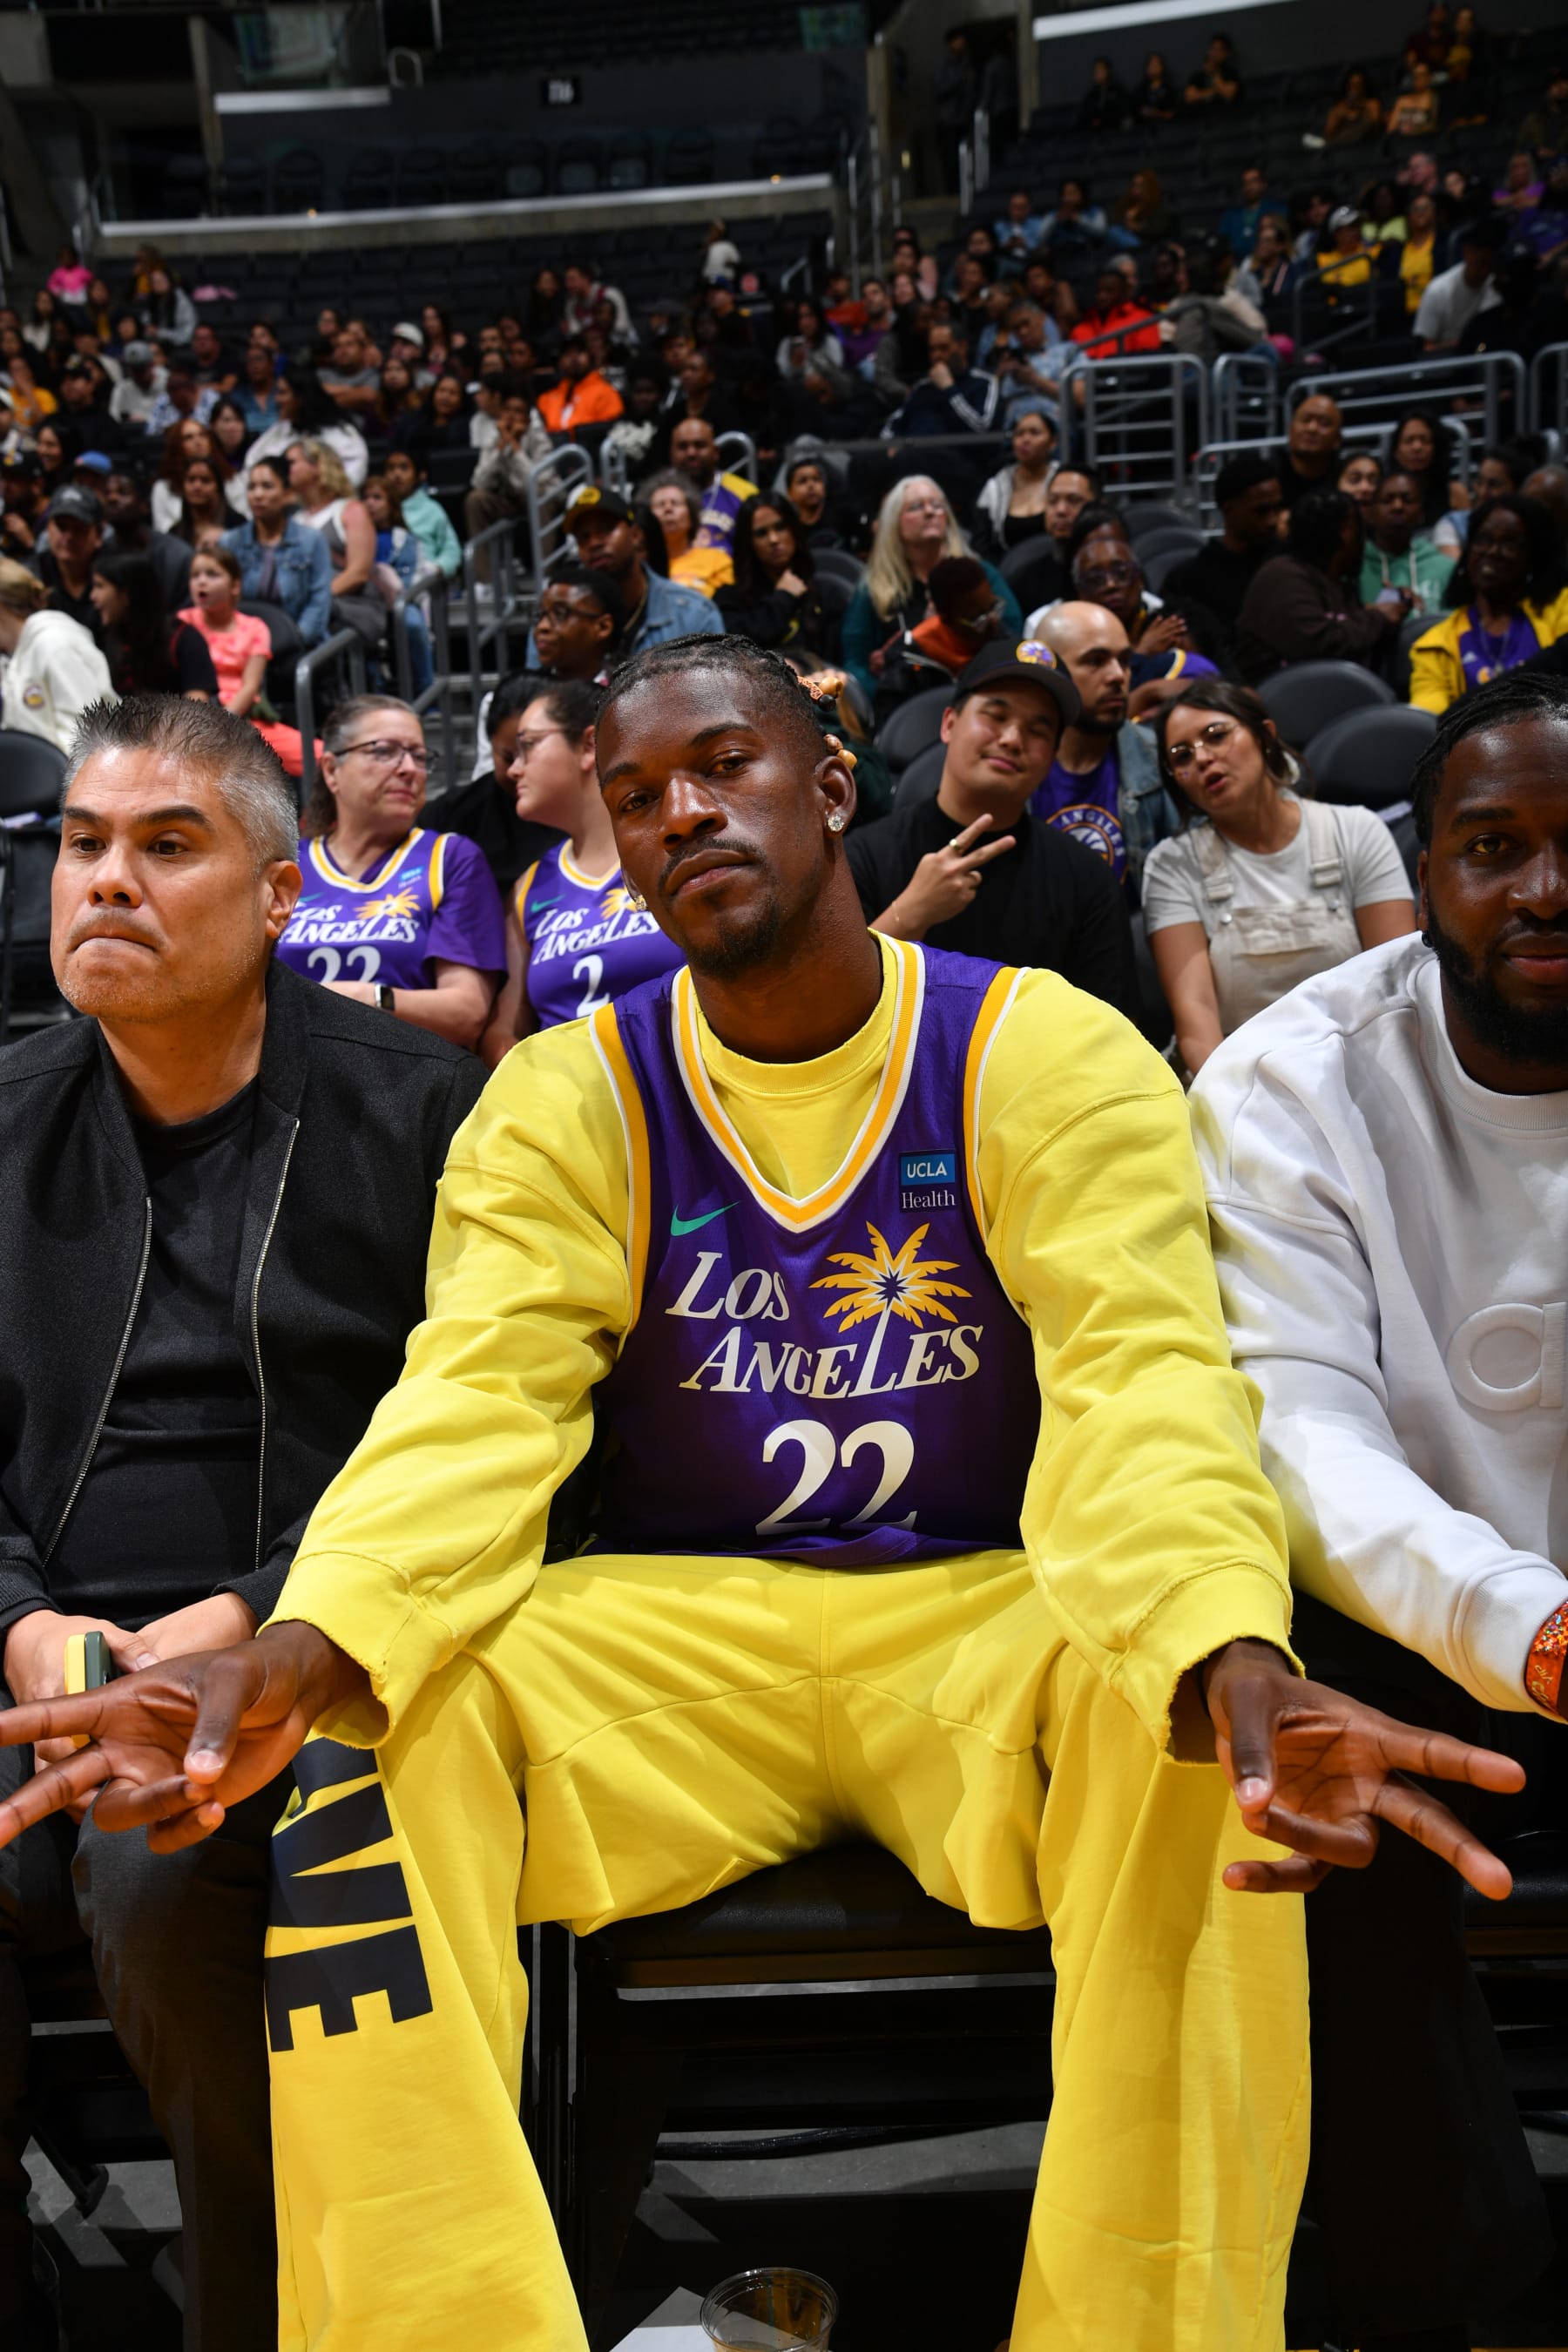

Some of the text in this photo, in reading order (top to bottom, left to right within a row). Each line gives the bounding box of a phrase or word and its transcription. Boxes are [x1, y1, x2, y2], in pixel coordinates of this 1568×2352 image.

[277, 916, 421, 943] ANGELES
[534, 908, 590, 941] LOS
[572, 954, 610, 1018] 2
[907, 1161, 948, 1179] UCLA
[901, 1189, 956, 1209] Health
[665, 1251, 790, 1321] LOS
[678, 1308, 984, 1399] ANGELES
[755, 1419, 917, 1536] 22
